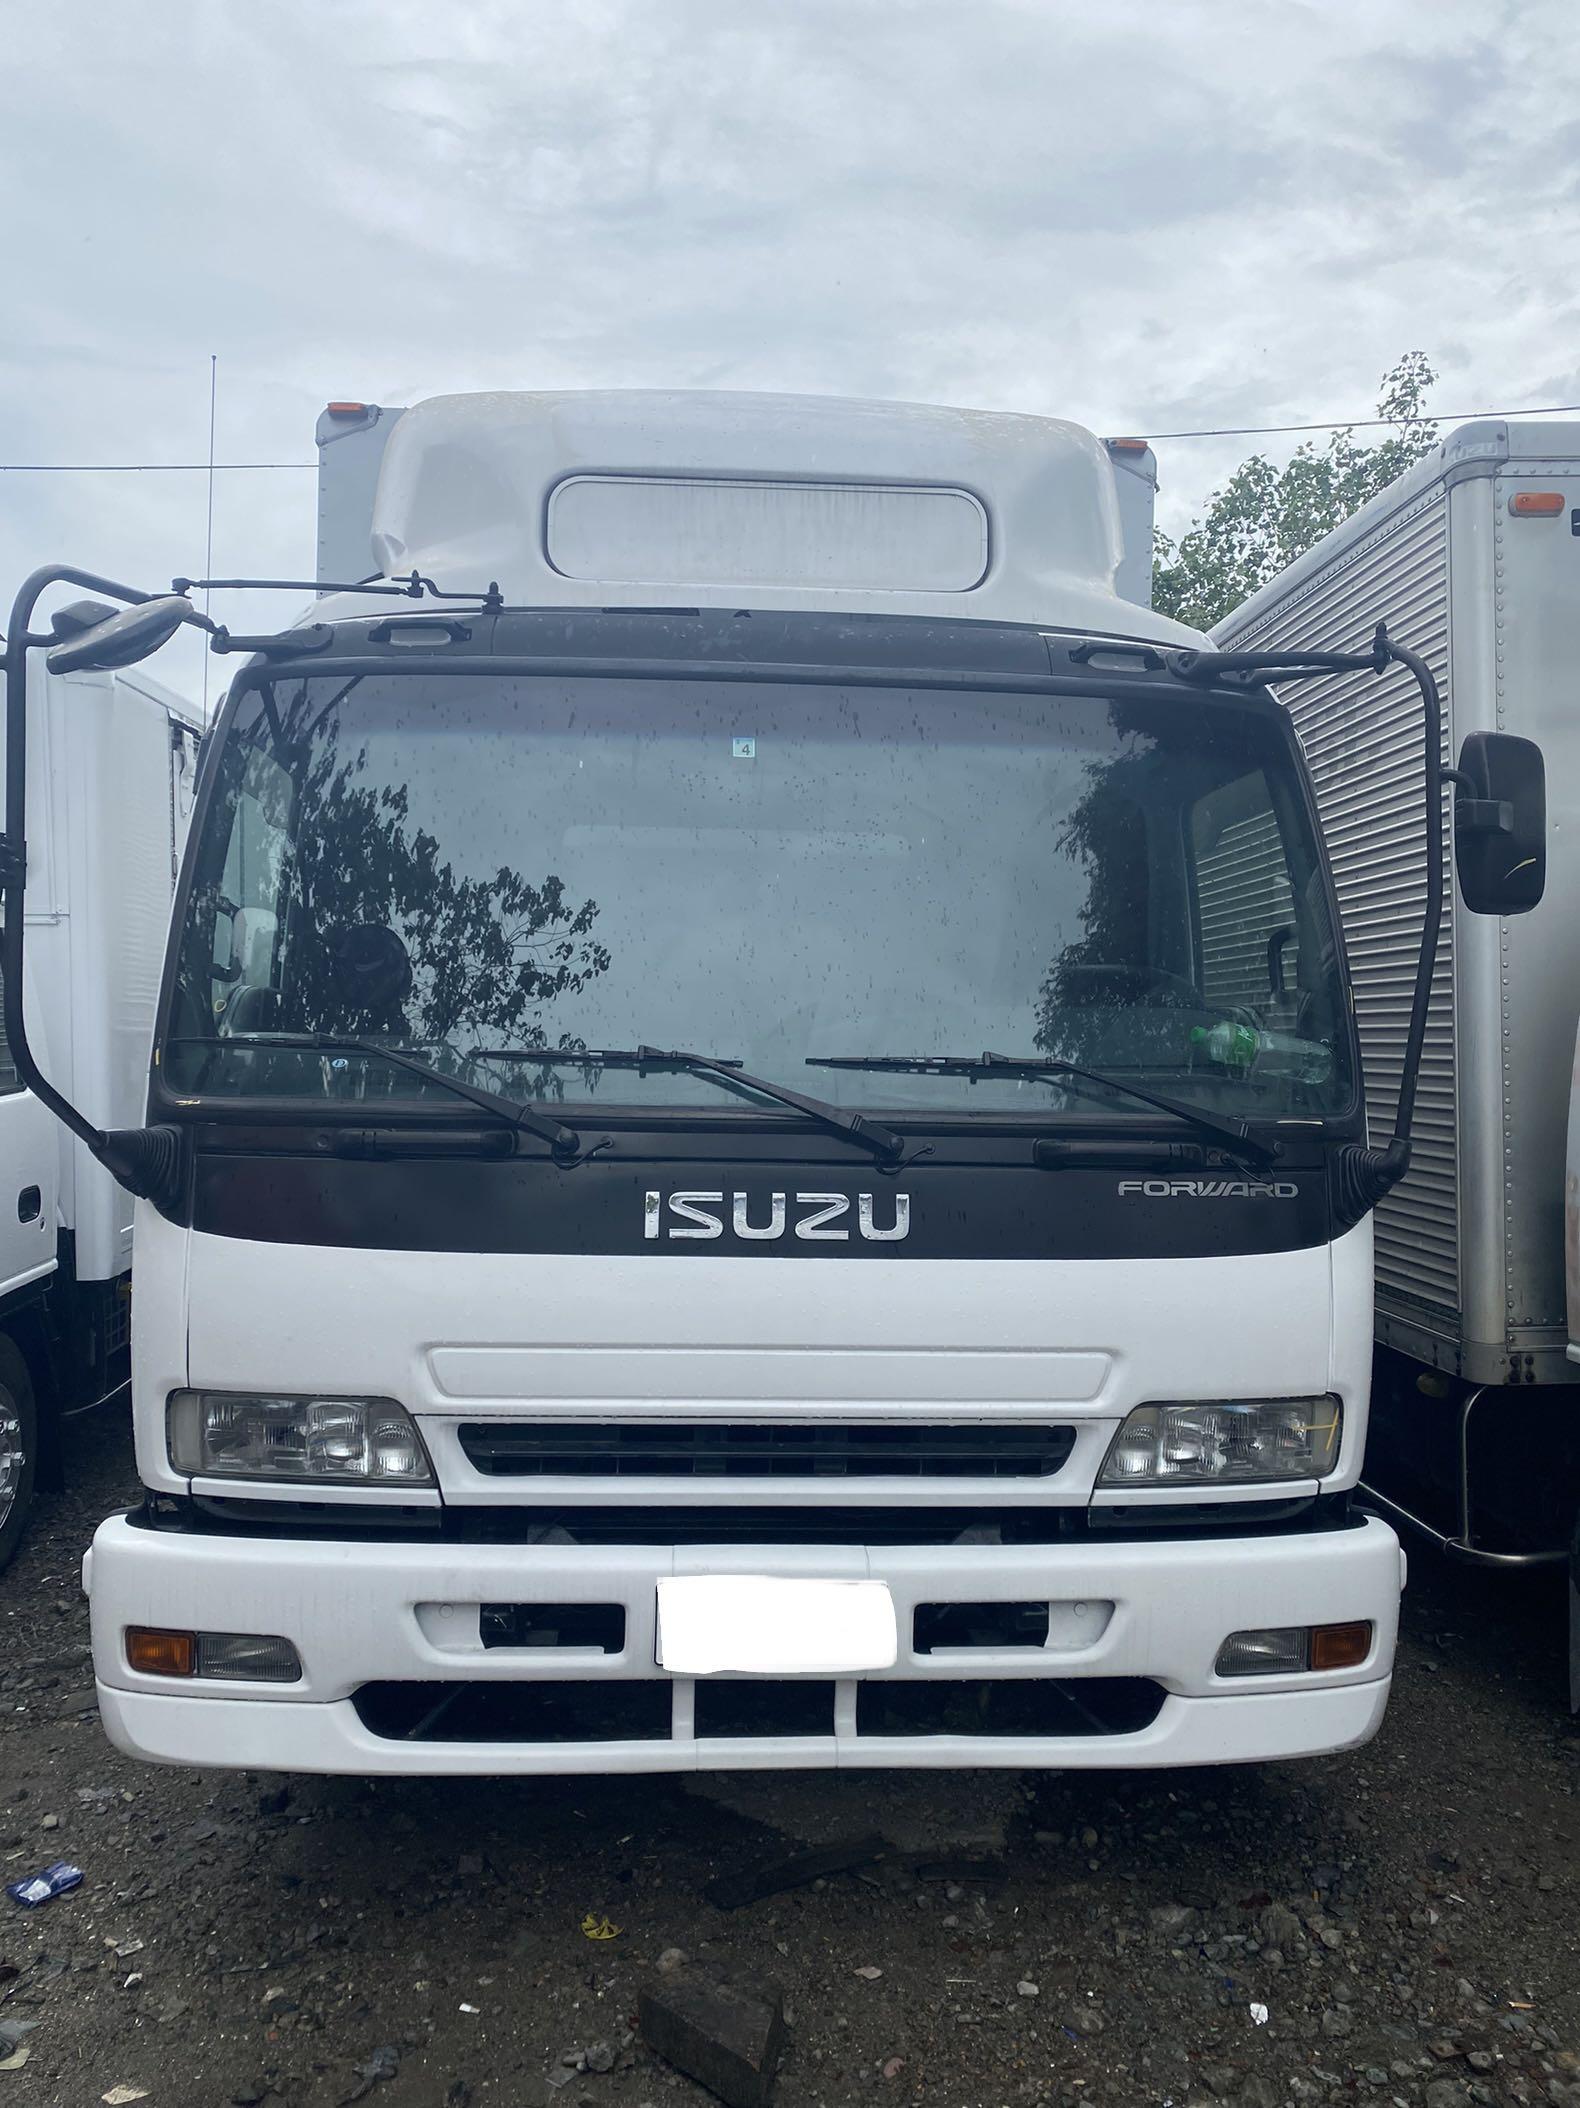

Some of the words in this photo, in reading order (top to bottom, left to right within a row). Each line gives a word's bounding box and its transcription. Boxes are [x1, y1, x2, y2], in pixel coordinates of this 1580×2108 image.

[742, 744, 750, 755] 4
[1118, 1181, 1299, 1198] FORWARD
[644, 1191, 910, 1240] ISUZU
